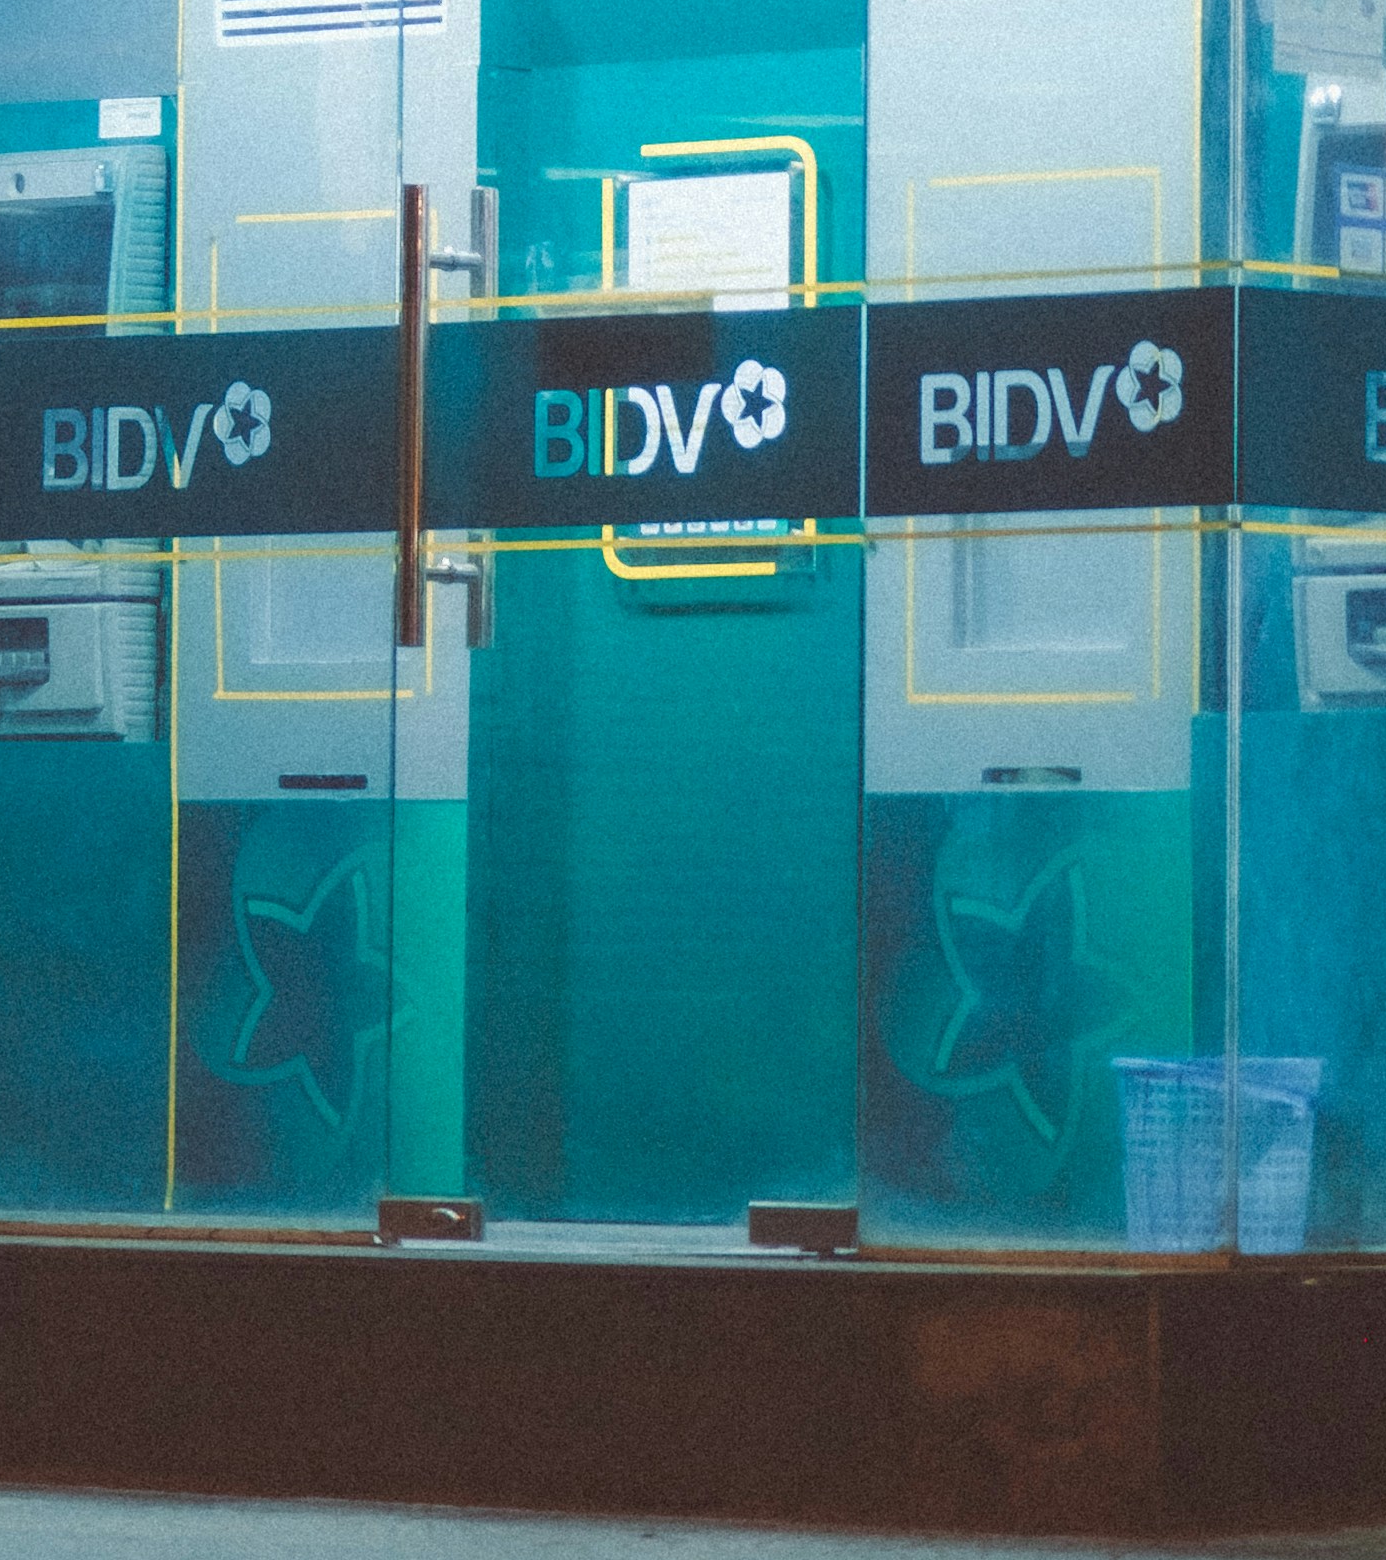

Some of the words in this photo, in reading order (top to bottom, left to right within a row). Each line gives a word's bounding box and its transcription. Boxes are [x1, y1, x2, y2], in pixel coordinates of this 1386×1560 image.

[42, 403, 213, 492] BIDV
[534, 384, 721, 478] BIDV
[920, 365, 1115, 465] BIDV
